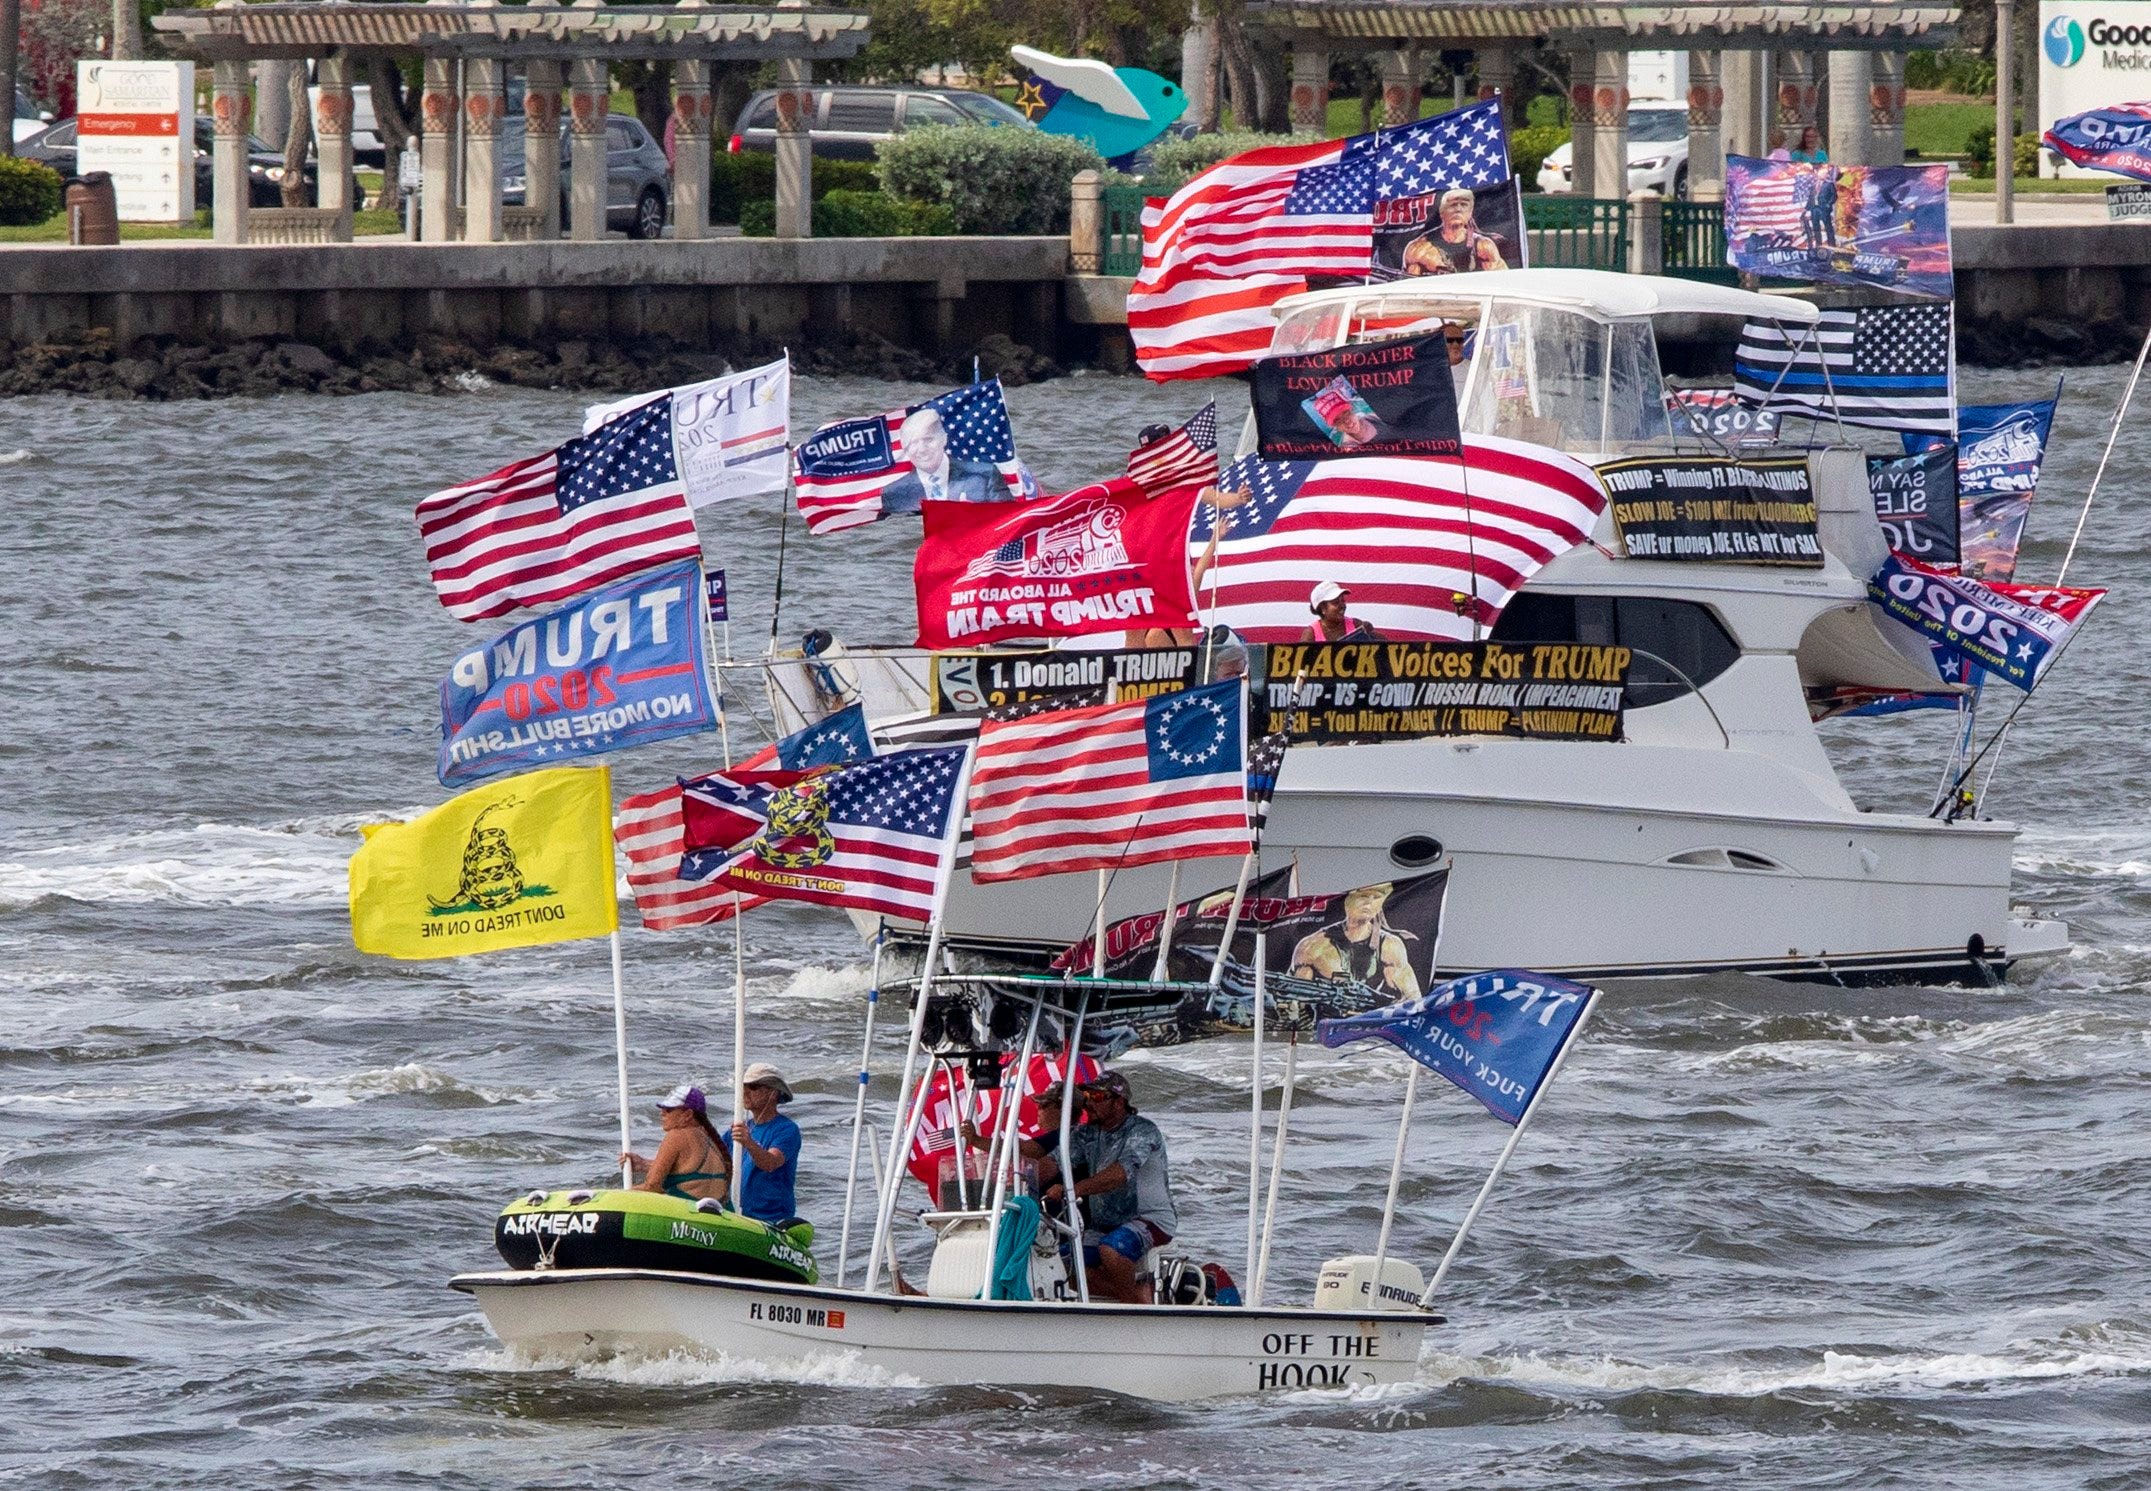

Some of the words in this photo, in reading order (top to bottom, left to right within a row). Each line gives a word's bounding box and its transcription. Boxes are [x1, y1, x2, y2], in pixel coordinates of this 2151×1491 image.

[2103, 49, 2151, 70] Medic
[84, 119, 137, 131] Emergency
[1279, 354, 1337, 369] BLACK
[1341, 345, 1416, 368] BOATER
[1350, 368, 1414, 389] TRUMP
[1604, 470, 1653, 492] TRUMP
[1662, 468, 1713, 490] Winning
[1712, 467, 1726, 487] FL
[1615, 502, 1655, 523] SLOW
[1657, 502, 1675, 520] JOE
[1686, 502, 1712, 521] $100
[1625, 534, 1658, 554] SAVE
[1658, 536, 1674, 554] ur
[1674, 536, 1713, 555] money
[1732, 532, 1746, 553] FL
[1745, 532, 1760, 552] is
[1784, 579, 1828, 588] SILVERTON
[990, 663, 1009, 689] 1.
[1014, 656, 1104, 688] Donald
[1113, 651, 1193, 683] TRUMP
[1271, 645, 1380, 679] BLACK
[1388, 642, 1474, 678] Voices
[1481, 646, 1525, 680] For
[1532, 646, 1631, 682] TRUMP
[1334, 683, 1359, 706] VS
[1368, 683, 1415, 707] COVID
[1424, 682, 1478, 706] RUSSIA
[1475, 682, 1520, 707] HOAX
[1523, 684, 1624, 711] IMPEACHMENT
[1268, 711, 1308, 733] BIEN
[1459, 709, 1510, 732] TRUMP
[1521, 710, 1580, 733] PLATINUM
[1578, 712, 1617, 736] PLAN
[503, 1212, 600, 1236] AIRHEAD
[769, 1244, 813, 1272] AIRHEAD
[1361, 1281, 1425, 1308] EINRUDE
[750, 1302, 763, 1320] FL
[768, 1305, 802, 1324] 8030
[806, 1308, 826, 1327] MR
[1262, 1333, 1315, 1355] OFF
[1327, 1334, 1380, 1358] THE
[1258, 1362, 1351, 1391] HOOK
